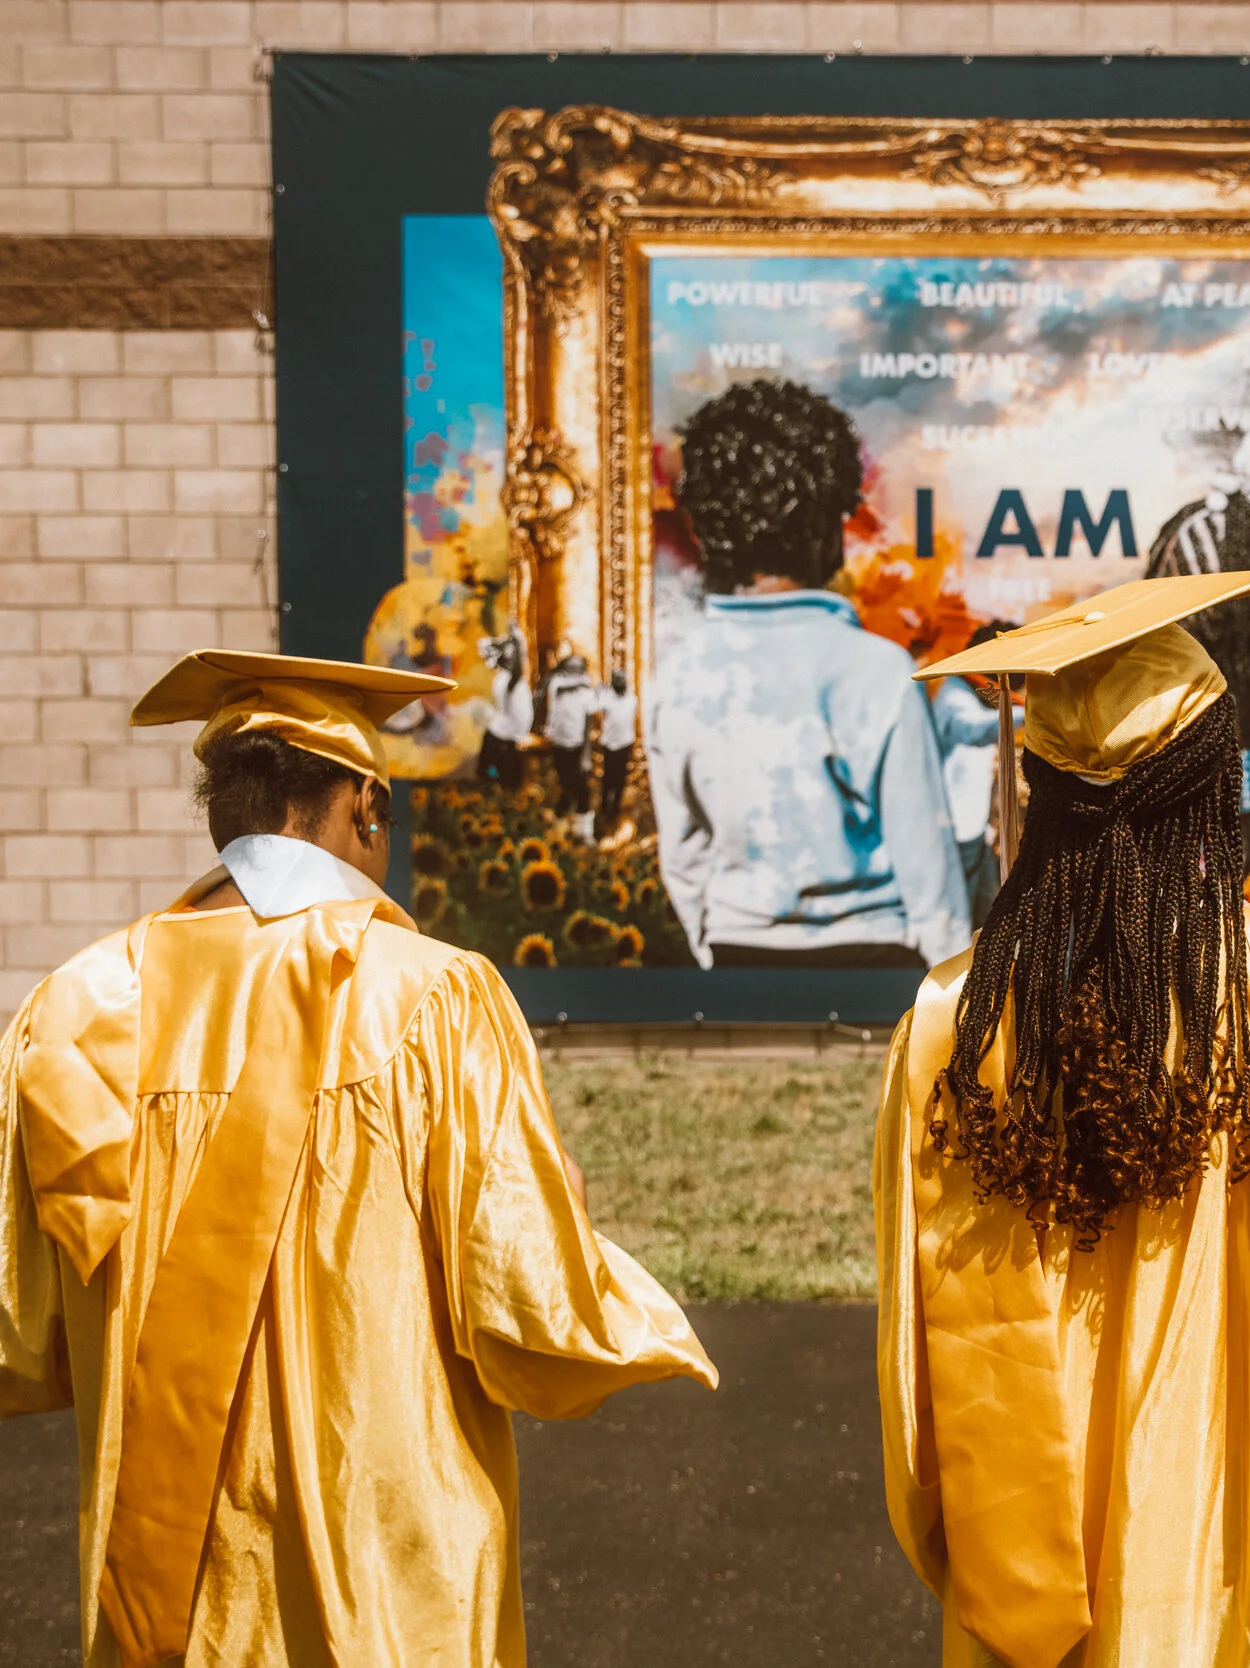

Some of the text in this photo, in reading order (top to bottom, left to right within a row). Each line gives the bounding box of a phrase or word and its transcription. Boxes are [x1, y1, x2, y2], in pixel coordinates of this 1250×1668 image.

[666, 281, 823, 308] POWERFUL
[920, 281, 1070, 308] BEAUTIFUL
[1161, 282, 1200, 308] AT
[709, 342, 784, 369] WISE
[859, 352, 1032, 380] IMPORTANT
[916, 488, 1139, 558] I AM
